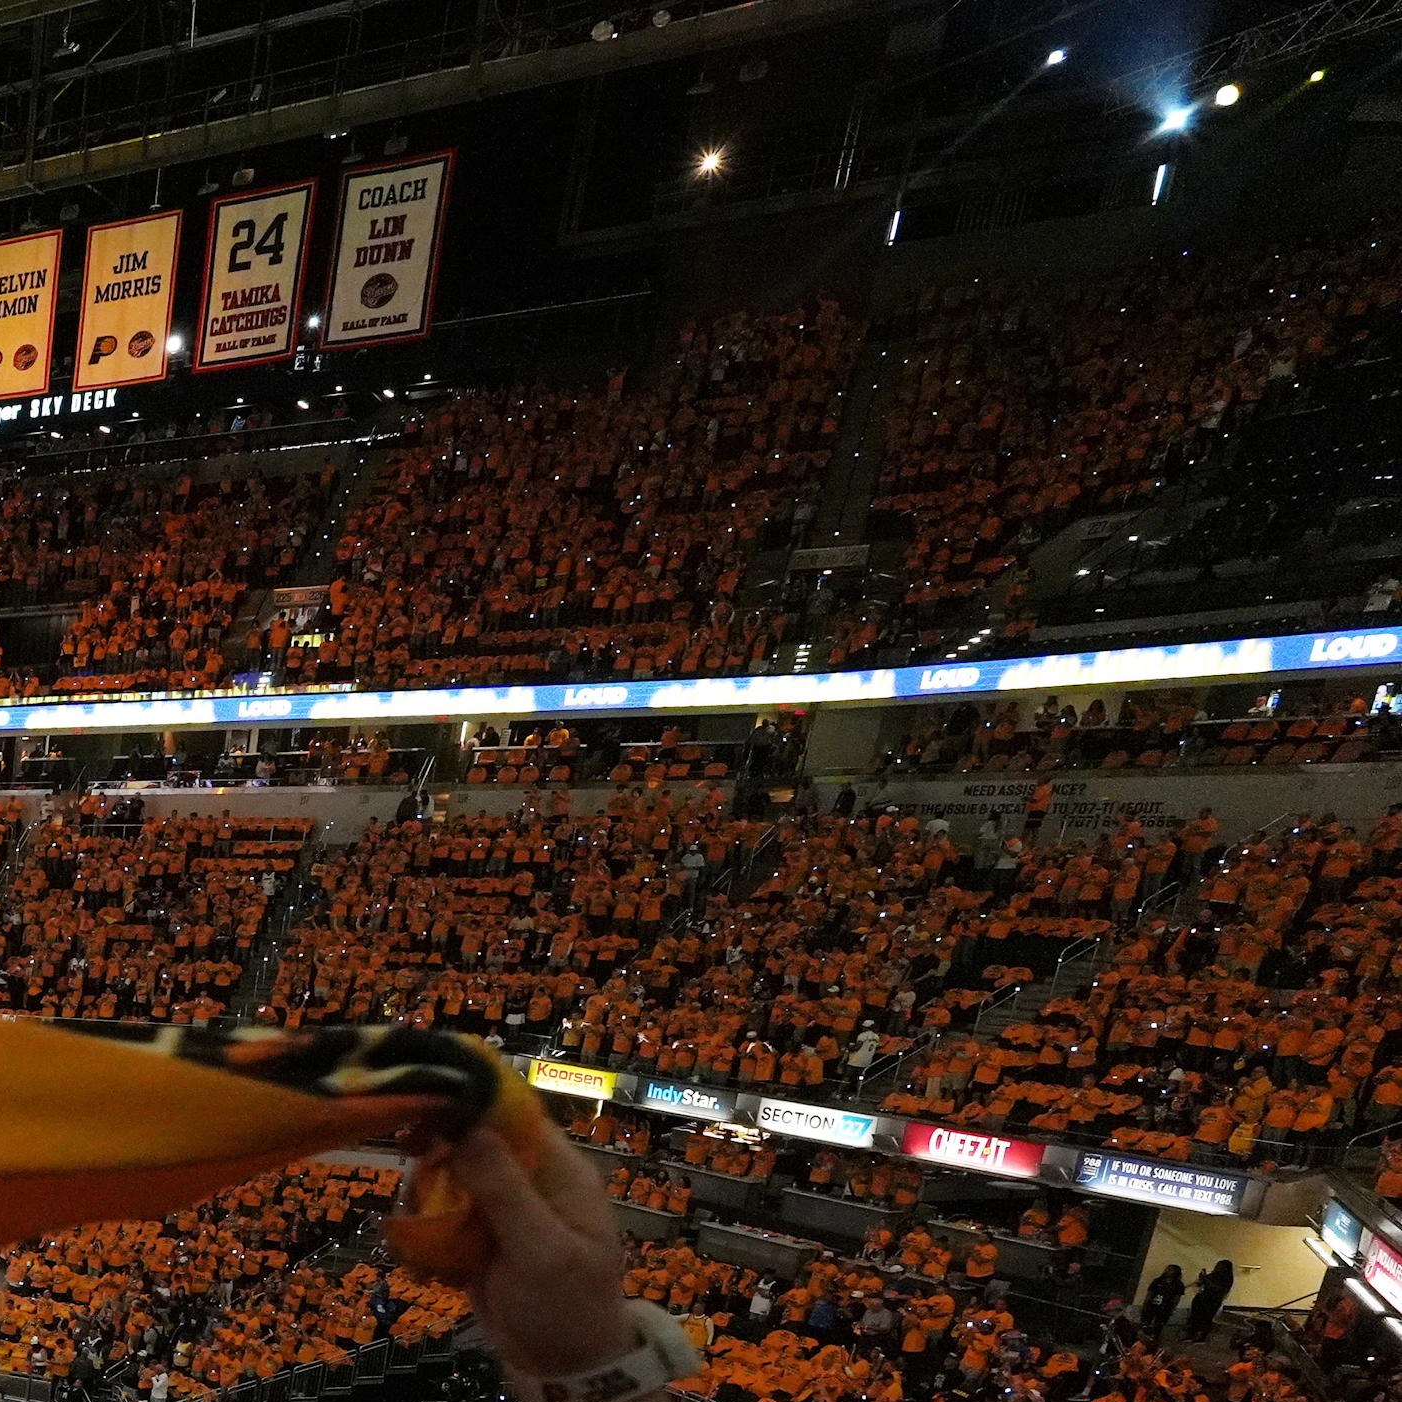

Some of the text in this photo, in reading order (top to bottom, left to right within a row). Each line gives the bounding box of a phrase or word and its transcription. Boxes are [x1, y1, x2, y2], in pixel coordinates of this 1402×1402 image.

[358, 178, 428, 210] COACH
[369, 214, 407, 240] LIN
[228, 212, 289, 273] 24
[354, 239, 414, 268] DUNN
[113, 250, 149, 274] JIM
[94, 275, 162, 304] MORRIS
[221, 283, 282, 311] TAMIKA
[210, 305, 288, 337] CATCHINGS
[342, 313, 409, 332] HALL OF FAME
[215, 334, 277, 353] HALL OF FAME
[29, 392, 63, 418] SKY
[71, 387, 118, 413] DECK
[1309, 633, 1398, 662] LOUD
[920, 667, 980, 690] LOUD
[238, 699, 292, 718] LOUD
[564, 686, 629, 706] LOUD
[964, 784, 1088, 796] NEED ASSISNCE?
[1068, 802, 1163, 814] 707-TIEOUT.
[536, 1062, 604, 1087] Koorsen
[646, 1082, 722, 1110] IndyStar.
[761, 1107, 836, 1130] SECTION
[1083, 1157, 1102, 1167] 988
[1107, 1174, 1118, 1185] IS
[1157, 1182, 1177, 1195] CALL
[1178, 1186, 1192, 1197] OR
[1193, 1188, 1214, 1201] TEXT
[1111, 1160, 1238, 1191] IF YOU OR SOMEONE YOU LOVE
